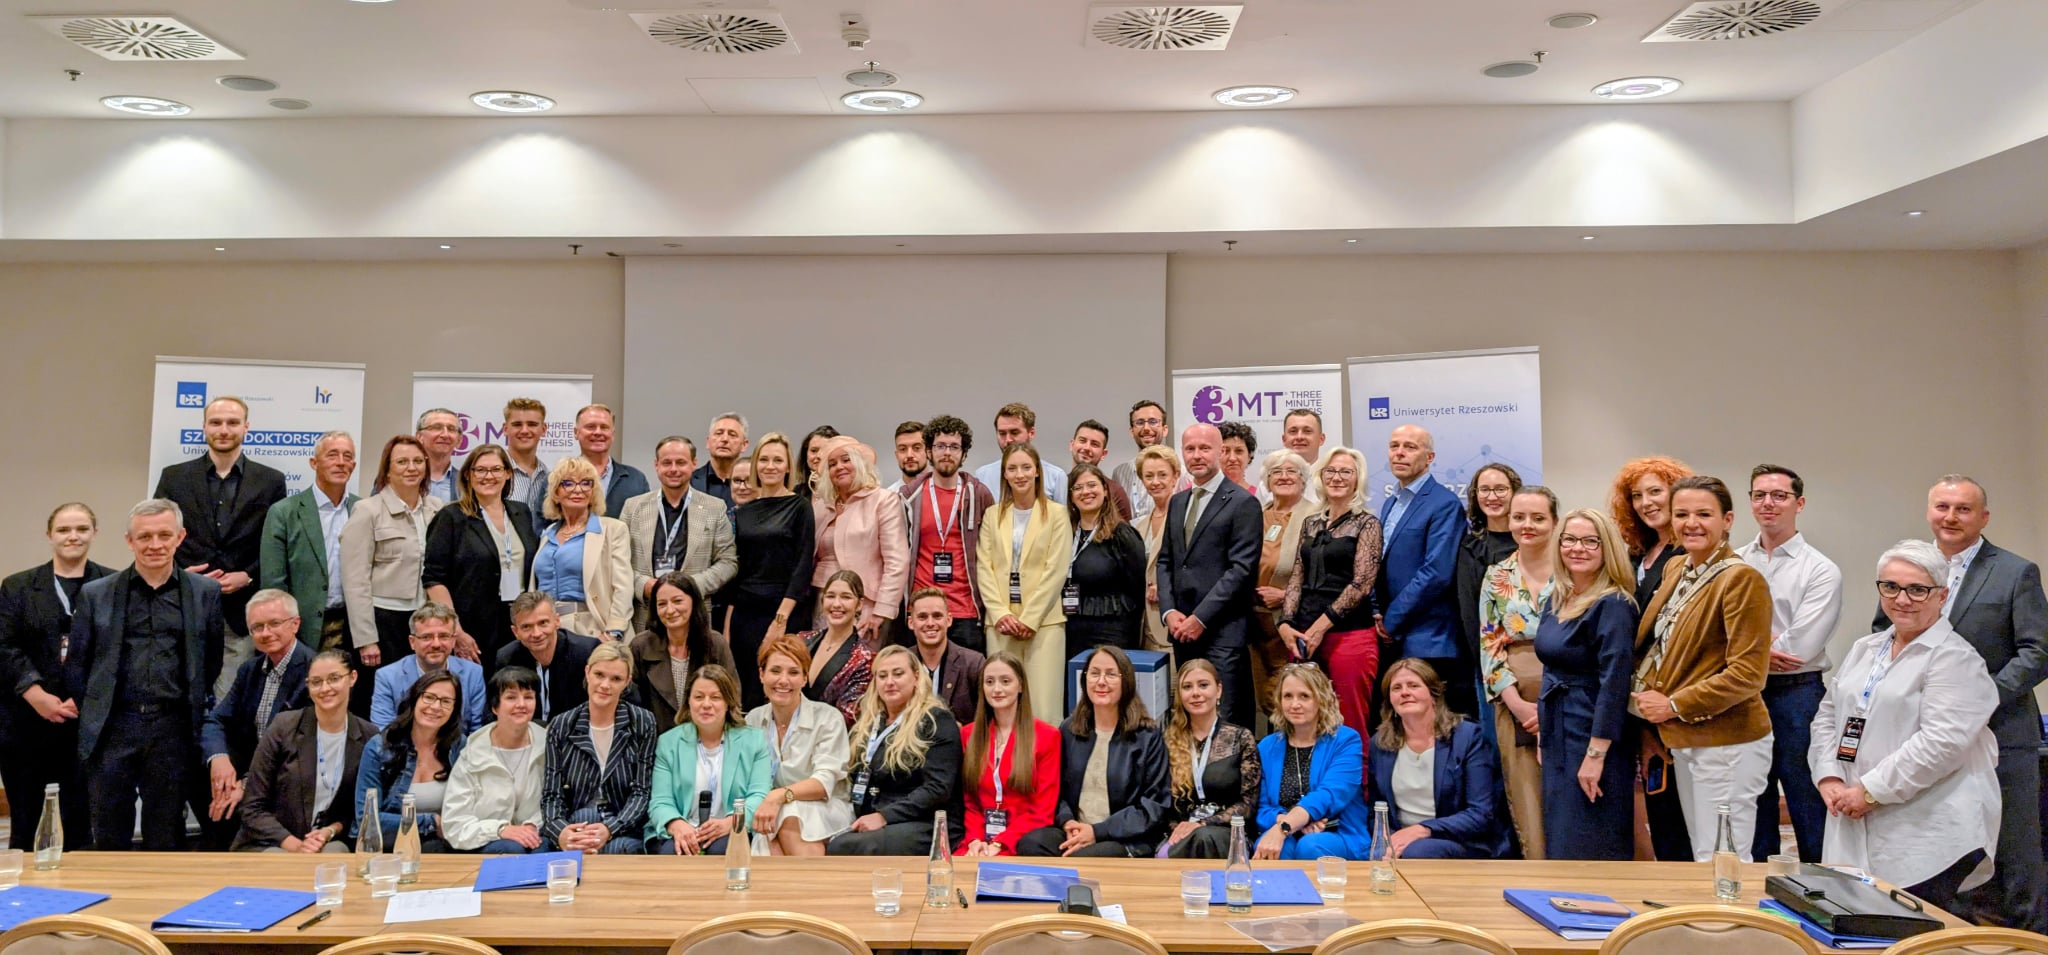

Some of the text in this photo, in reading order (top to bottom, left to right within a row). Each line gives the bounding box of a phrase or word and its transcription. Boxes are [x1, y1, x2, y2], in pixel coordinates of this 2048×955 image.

[315, 386, 333, 404] hr
[1290, 390, 1322, 399] THREE
[1285, 399, 1323, 408] MINUTE
[1393, 402, 1519, 418] Uniwersytet Rzeszowski
[547, 422, 574, 430] HREE
[245, 432, 320, 445] DOKTORSK
[540, 439, 574, 447] THESIS
